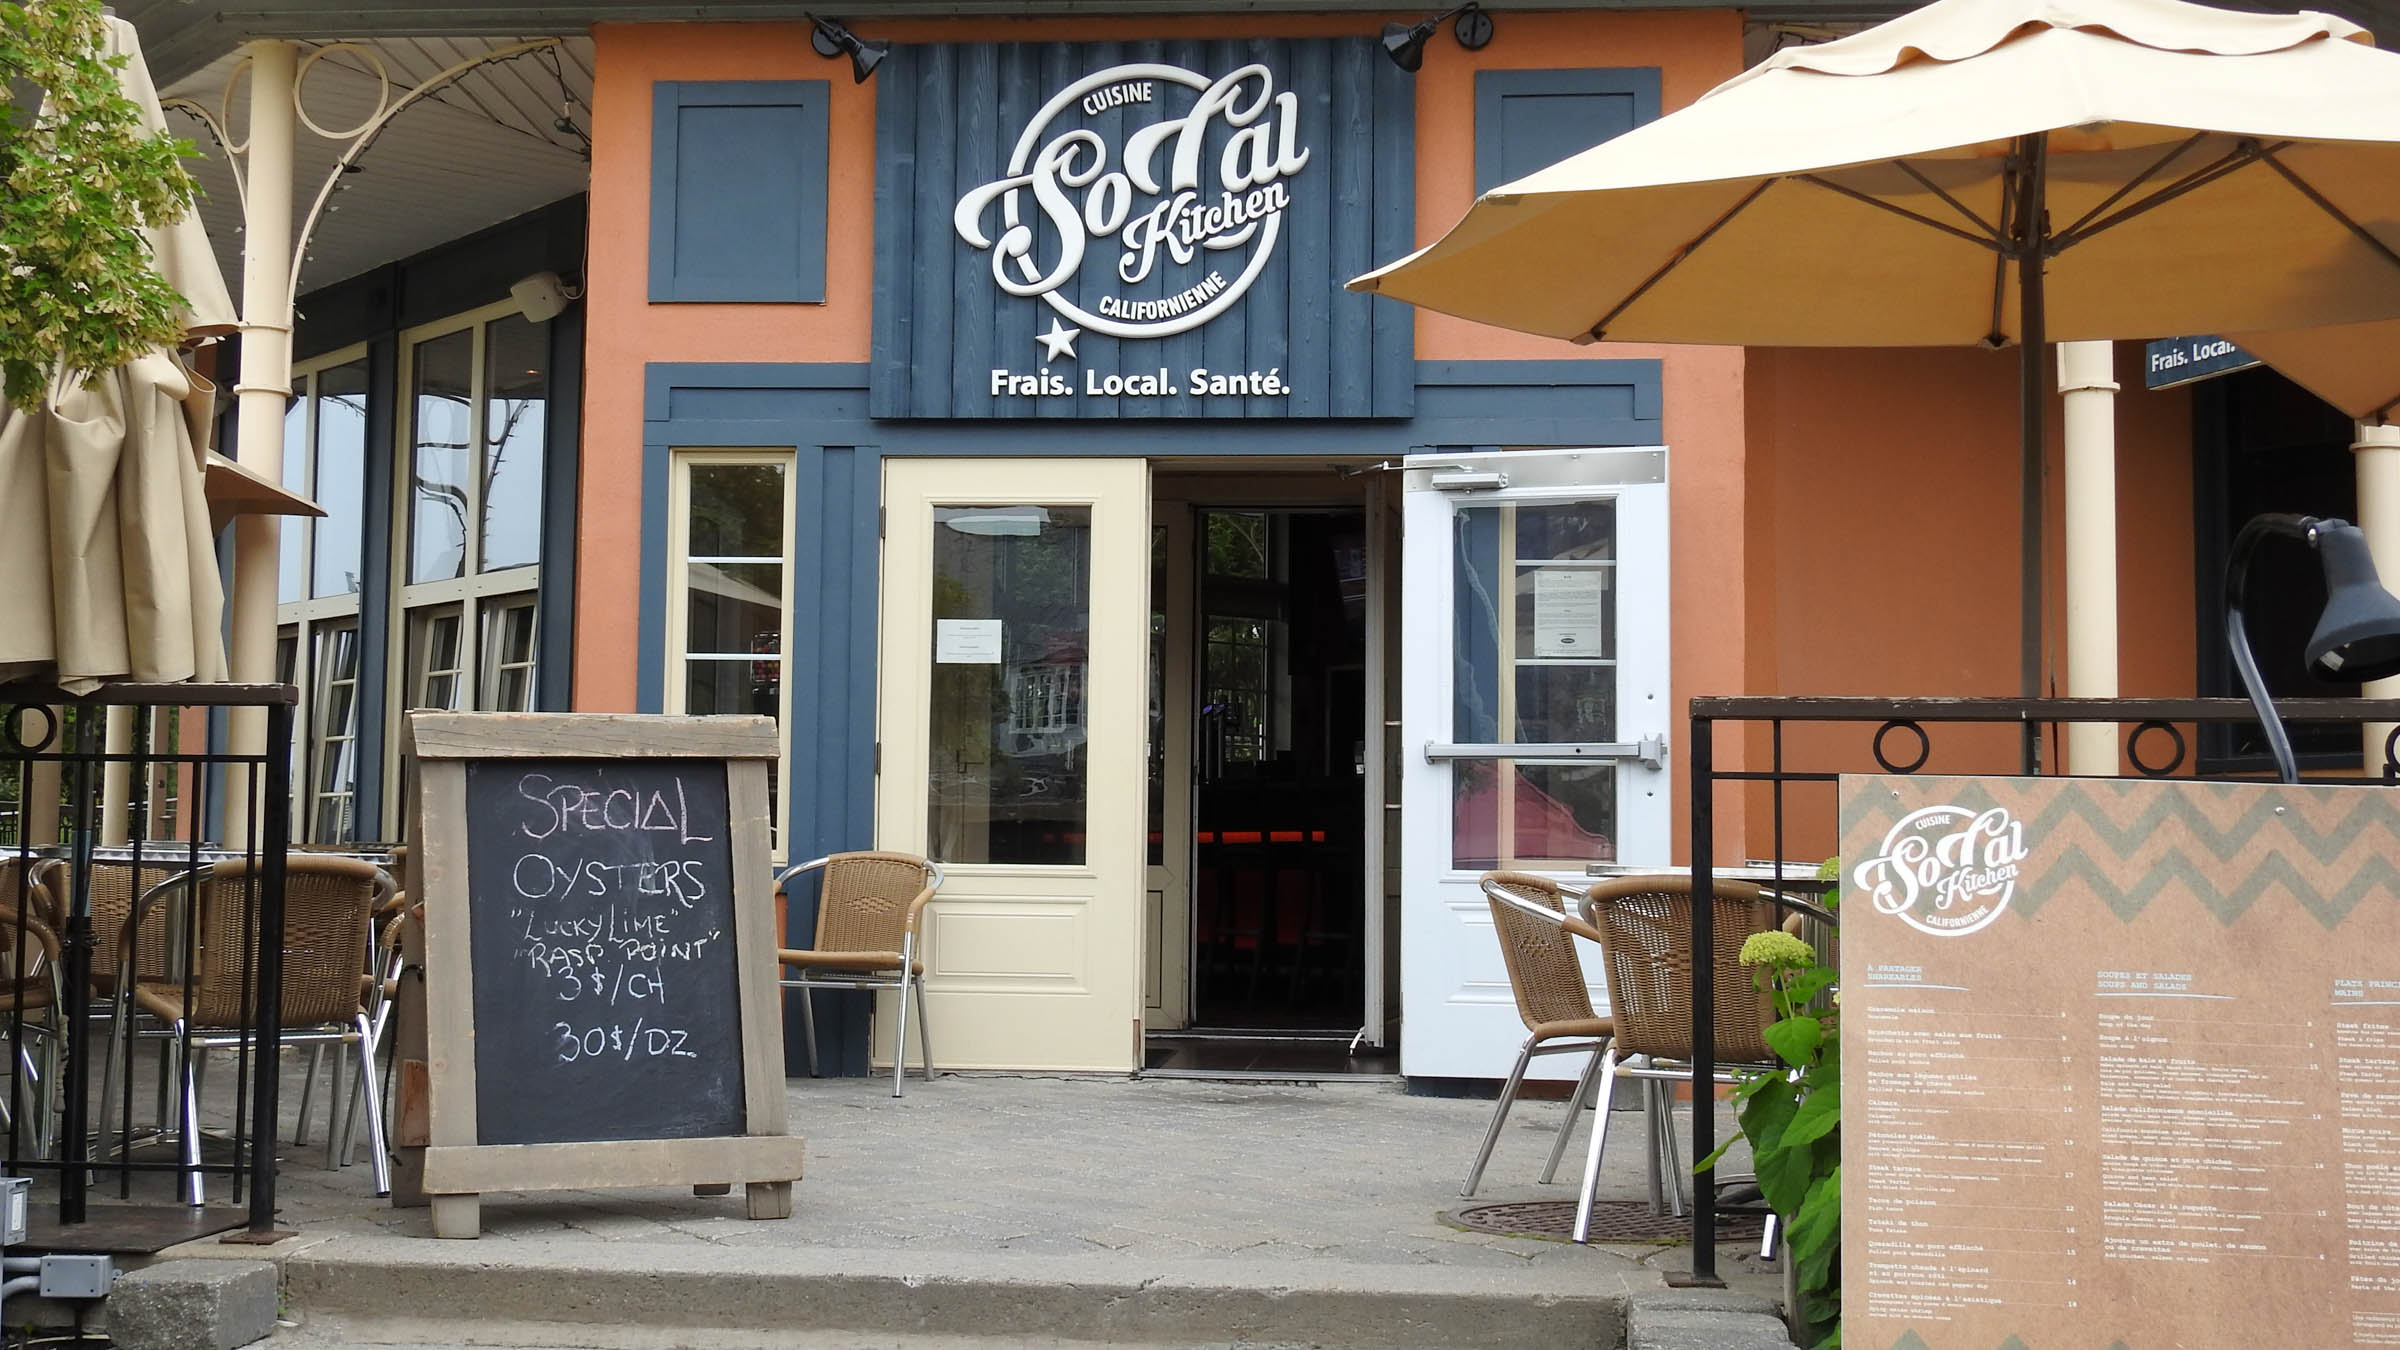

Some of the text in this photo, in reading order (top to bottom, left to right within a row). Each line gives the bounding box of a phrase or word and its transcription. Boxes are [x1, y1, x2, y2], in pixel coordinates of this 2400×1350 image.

[1083, 82, 1152, 116] CUISINE
[1119, 181, 1290, 283] Kitchen
[1099, 270, 1227, 321] CALIFORNIENNE
[2151, 348, 2189, 373] Frais.
[991, 368, 1291, 396] Frais. Local. Santé.
[518, 773, 713, 845] SPECIAL
[1915, 815, 1951, 830] CUISINE
[513, 853, 706, 907] OYSTERS
[1935, 864, 2019, 910] Kitchen
[1926, 905, 1990, 928] CALIFORNIENNE
